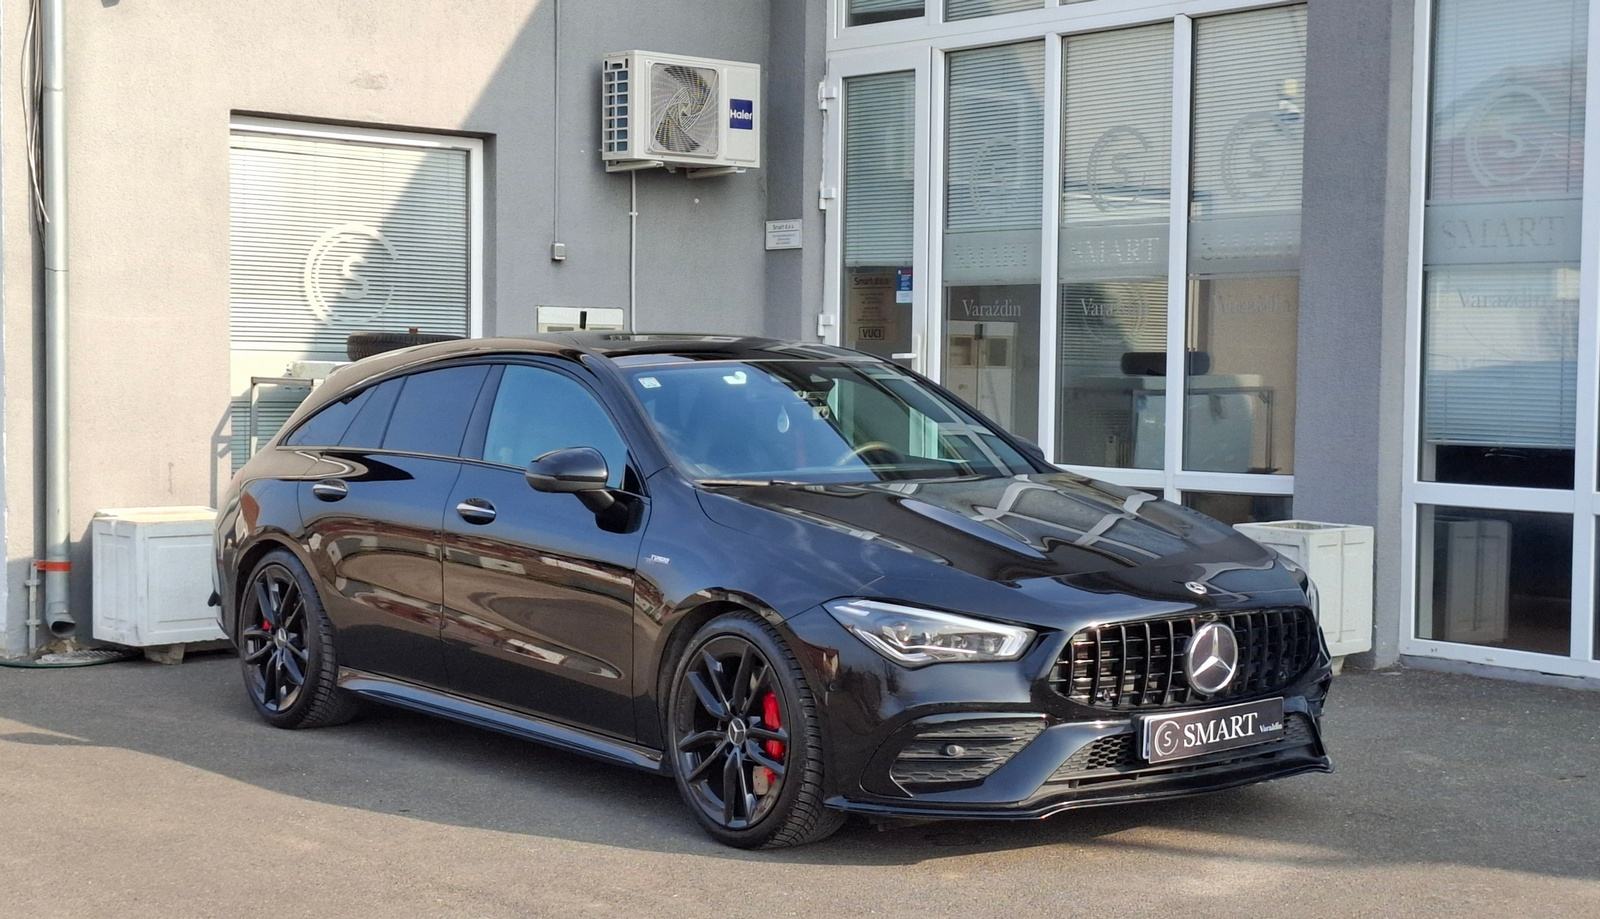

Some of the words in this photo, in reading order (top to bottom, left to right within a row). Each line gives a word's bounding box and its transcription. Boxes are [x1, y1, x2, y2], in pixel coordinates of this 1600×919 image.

[730, 108, 752, 120] Haier
[1442, 215, 1566, 249] SMART
[1071, 237, 1161, 264] SMART
[963, 298, 1022, 317] Varaždin
[862, 328, 882, 338] VUCI
[1184, 712, 1258, 748] SMART
